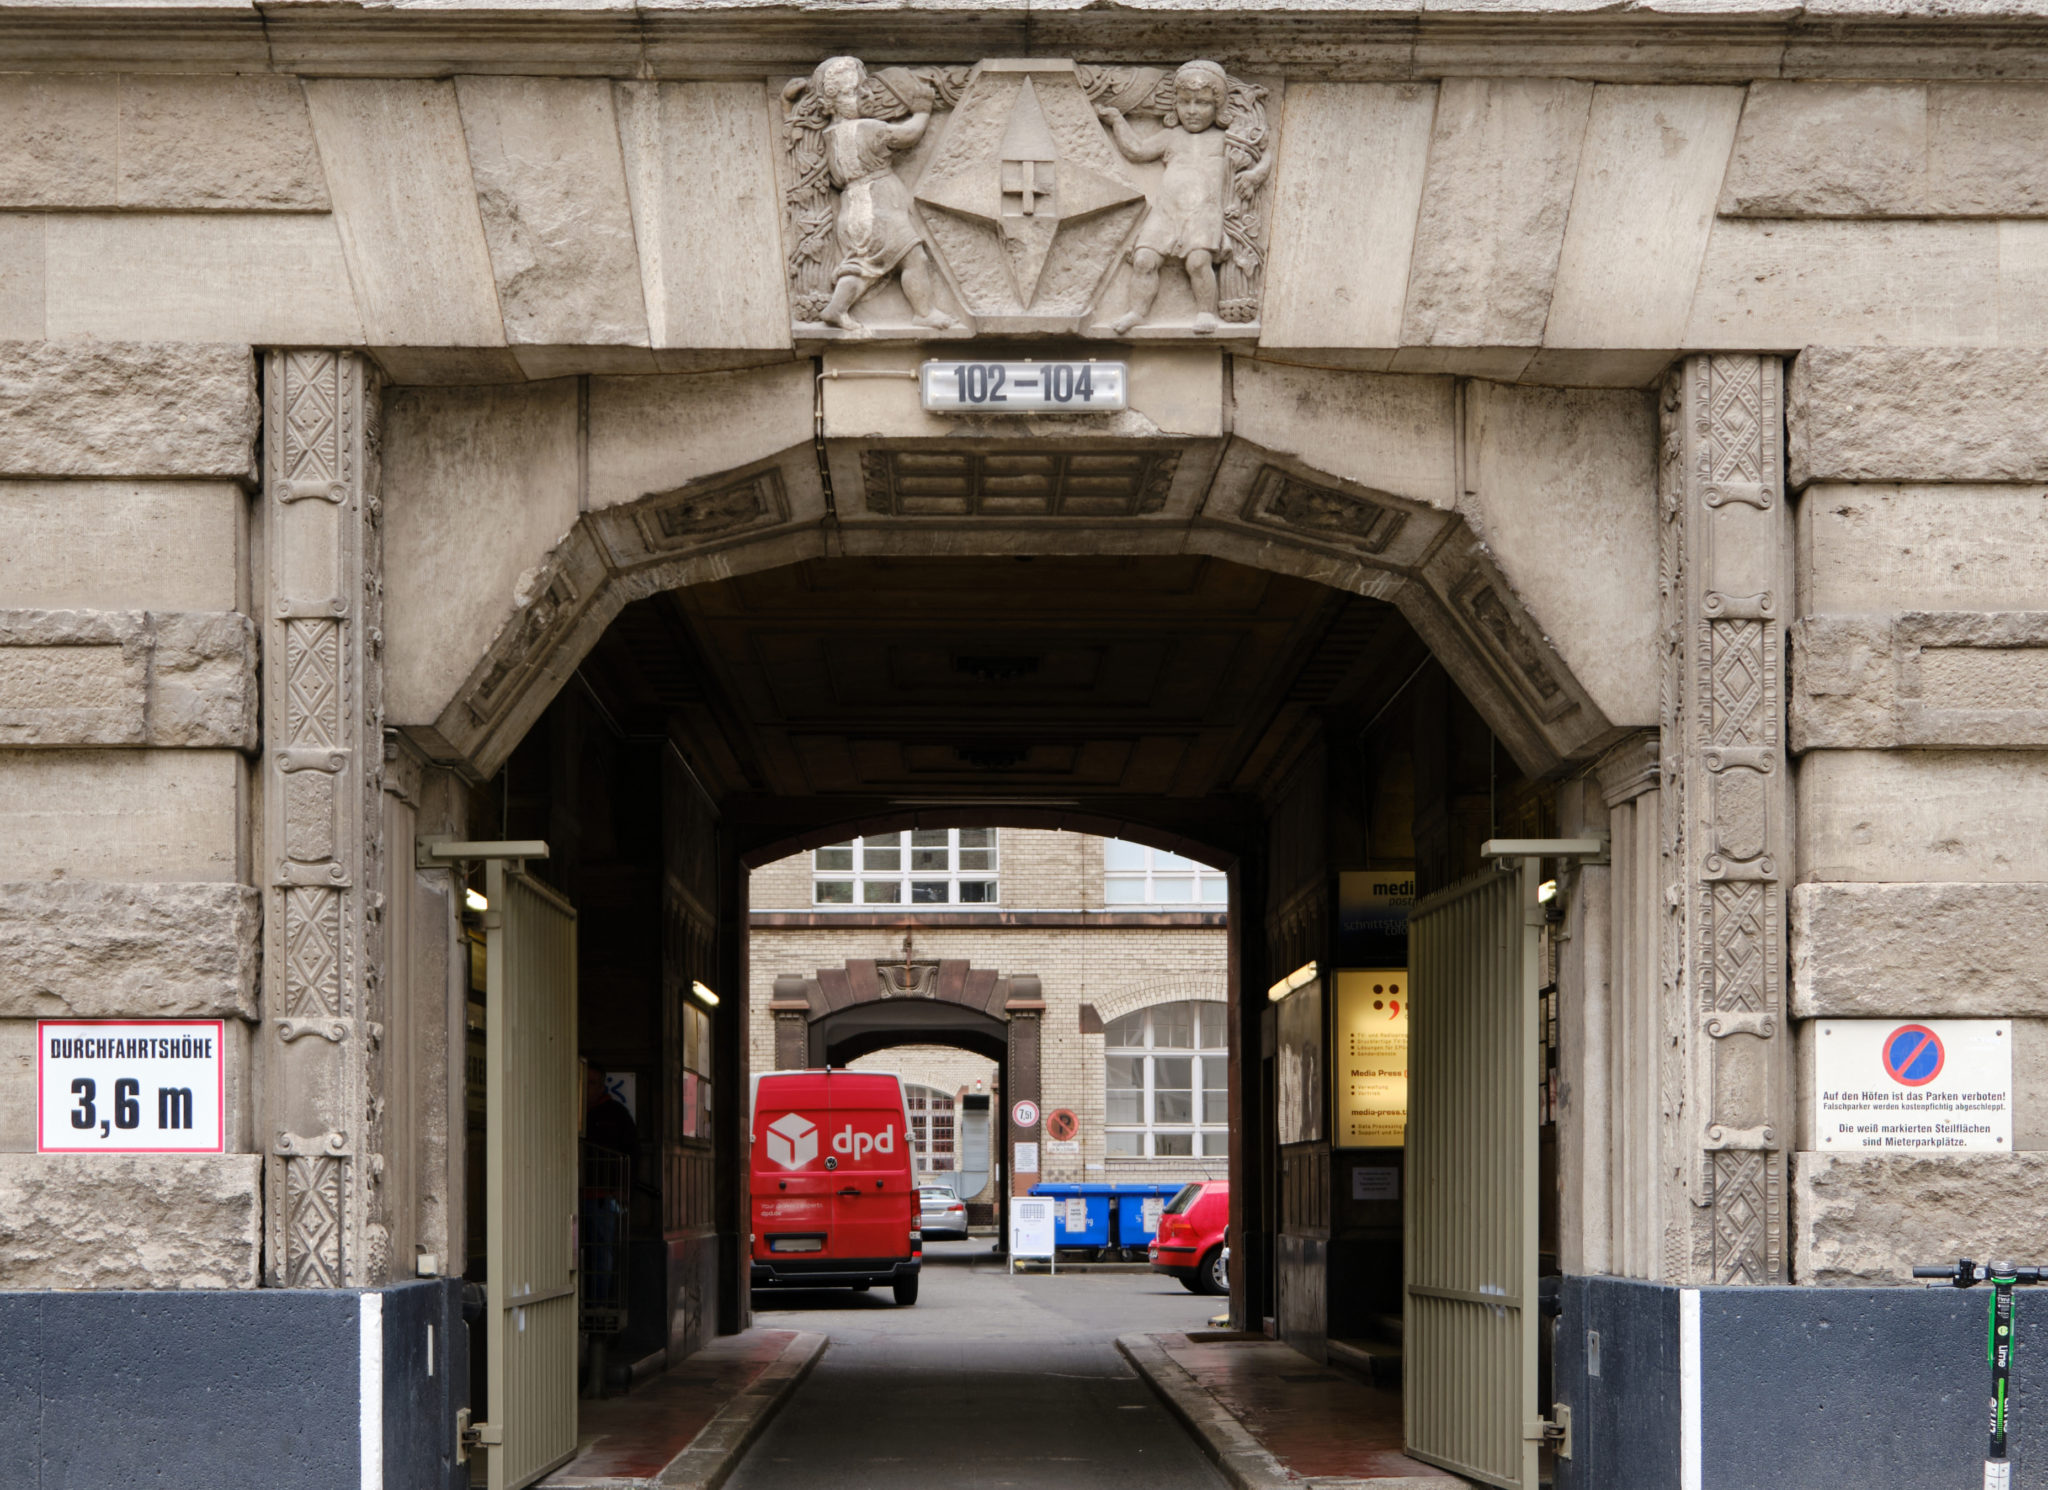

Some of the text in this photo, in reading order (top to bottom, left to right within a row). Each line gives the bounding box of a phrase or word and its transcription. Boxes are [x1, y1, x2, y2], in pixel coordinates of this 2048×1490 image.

[51, 1035, 212, 1058] DURCHFAHRTSHÖHE
[1351, 1069, 1376, 1077] Media
[1378, 1069, 1402, 1077] Press
[1823, 1091, 2006, 1101] Auf den Höfen ist das Parken verboten!
[71, 1078, 193, 1138] 3,6 m
[1823, 1103, 1870, 1111] Falschparker
[1955, 1103, 2006, 1112] abgeschleppt.
[1838, 1123, 1991, 1133] Die weiß markierten Stellflächen
[832, 1124, 894, 1161] dpd
[1862, 1137, 1967, 1148] sind Mieterparkplätze.
[1998, 1345, 2008, 1368] Lime
